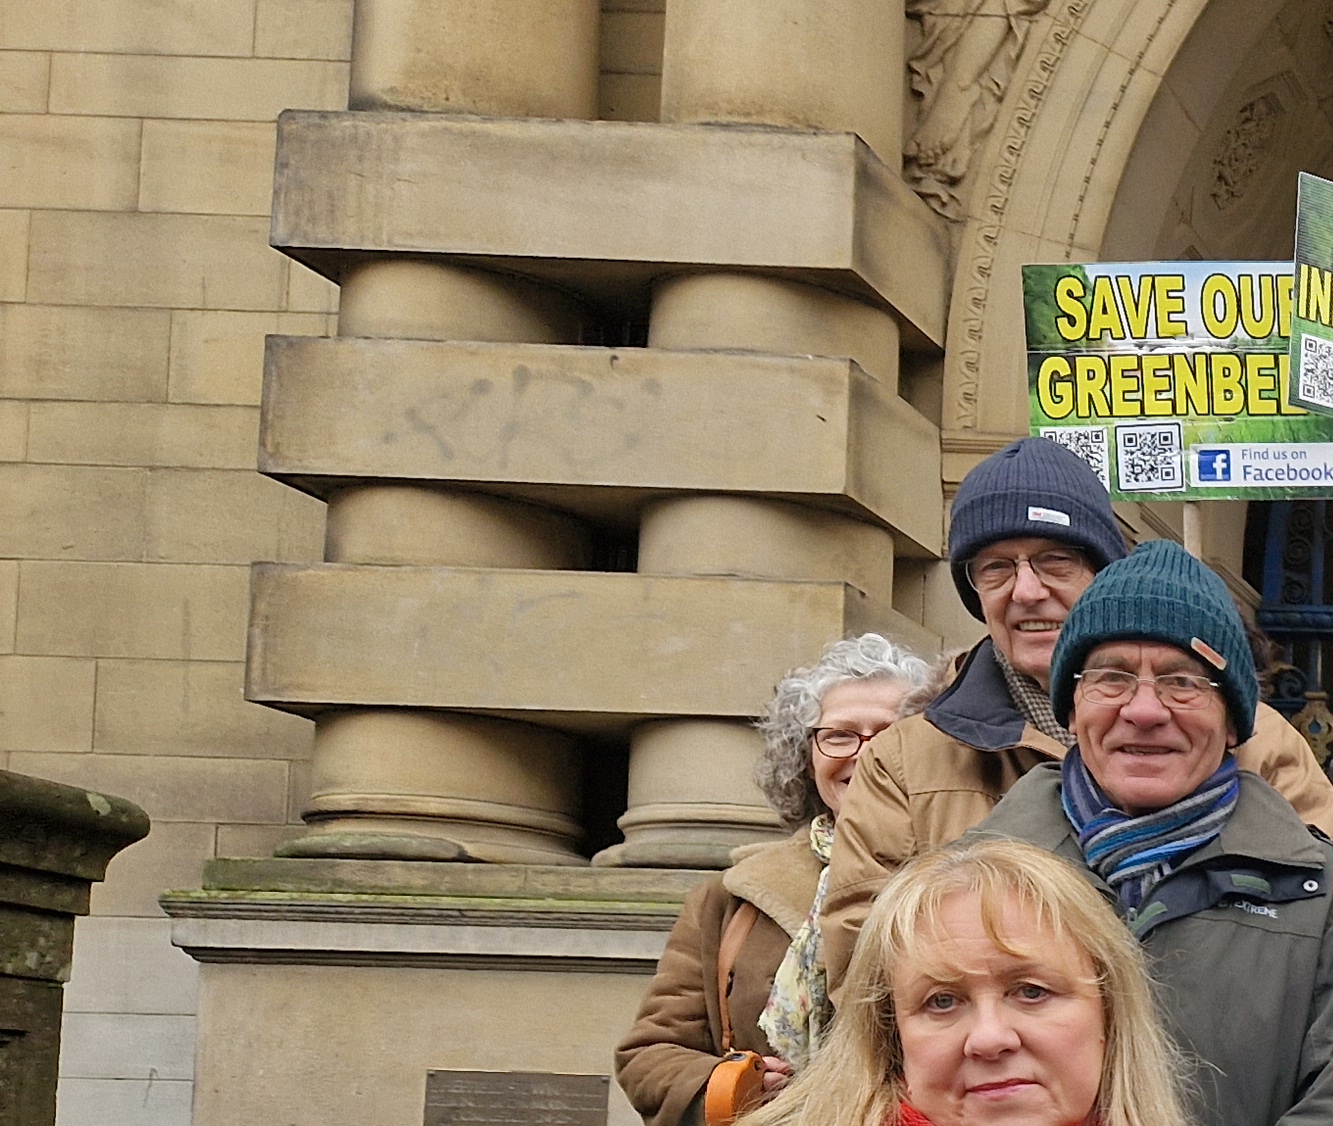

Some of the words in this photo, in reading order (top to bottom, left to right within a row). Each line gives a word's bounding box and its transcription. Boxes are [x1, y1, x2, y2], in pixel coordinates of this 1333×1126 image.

[1055, 275, 1188, 341] SAVE
[1037, 354, 1308, 418] GREENBEL
[1241, 448, 1269, 460] Find
[1273, 450, 1287, 460] us
[1291, 449, 1307, 460] on
